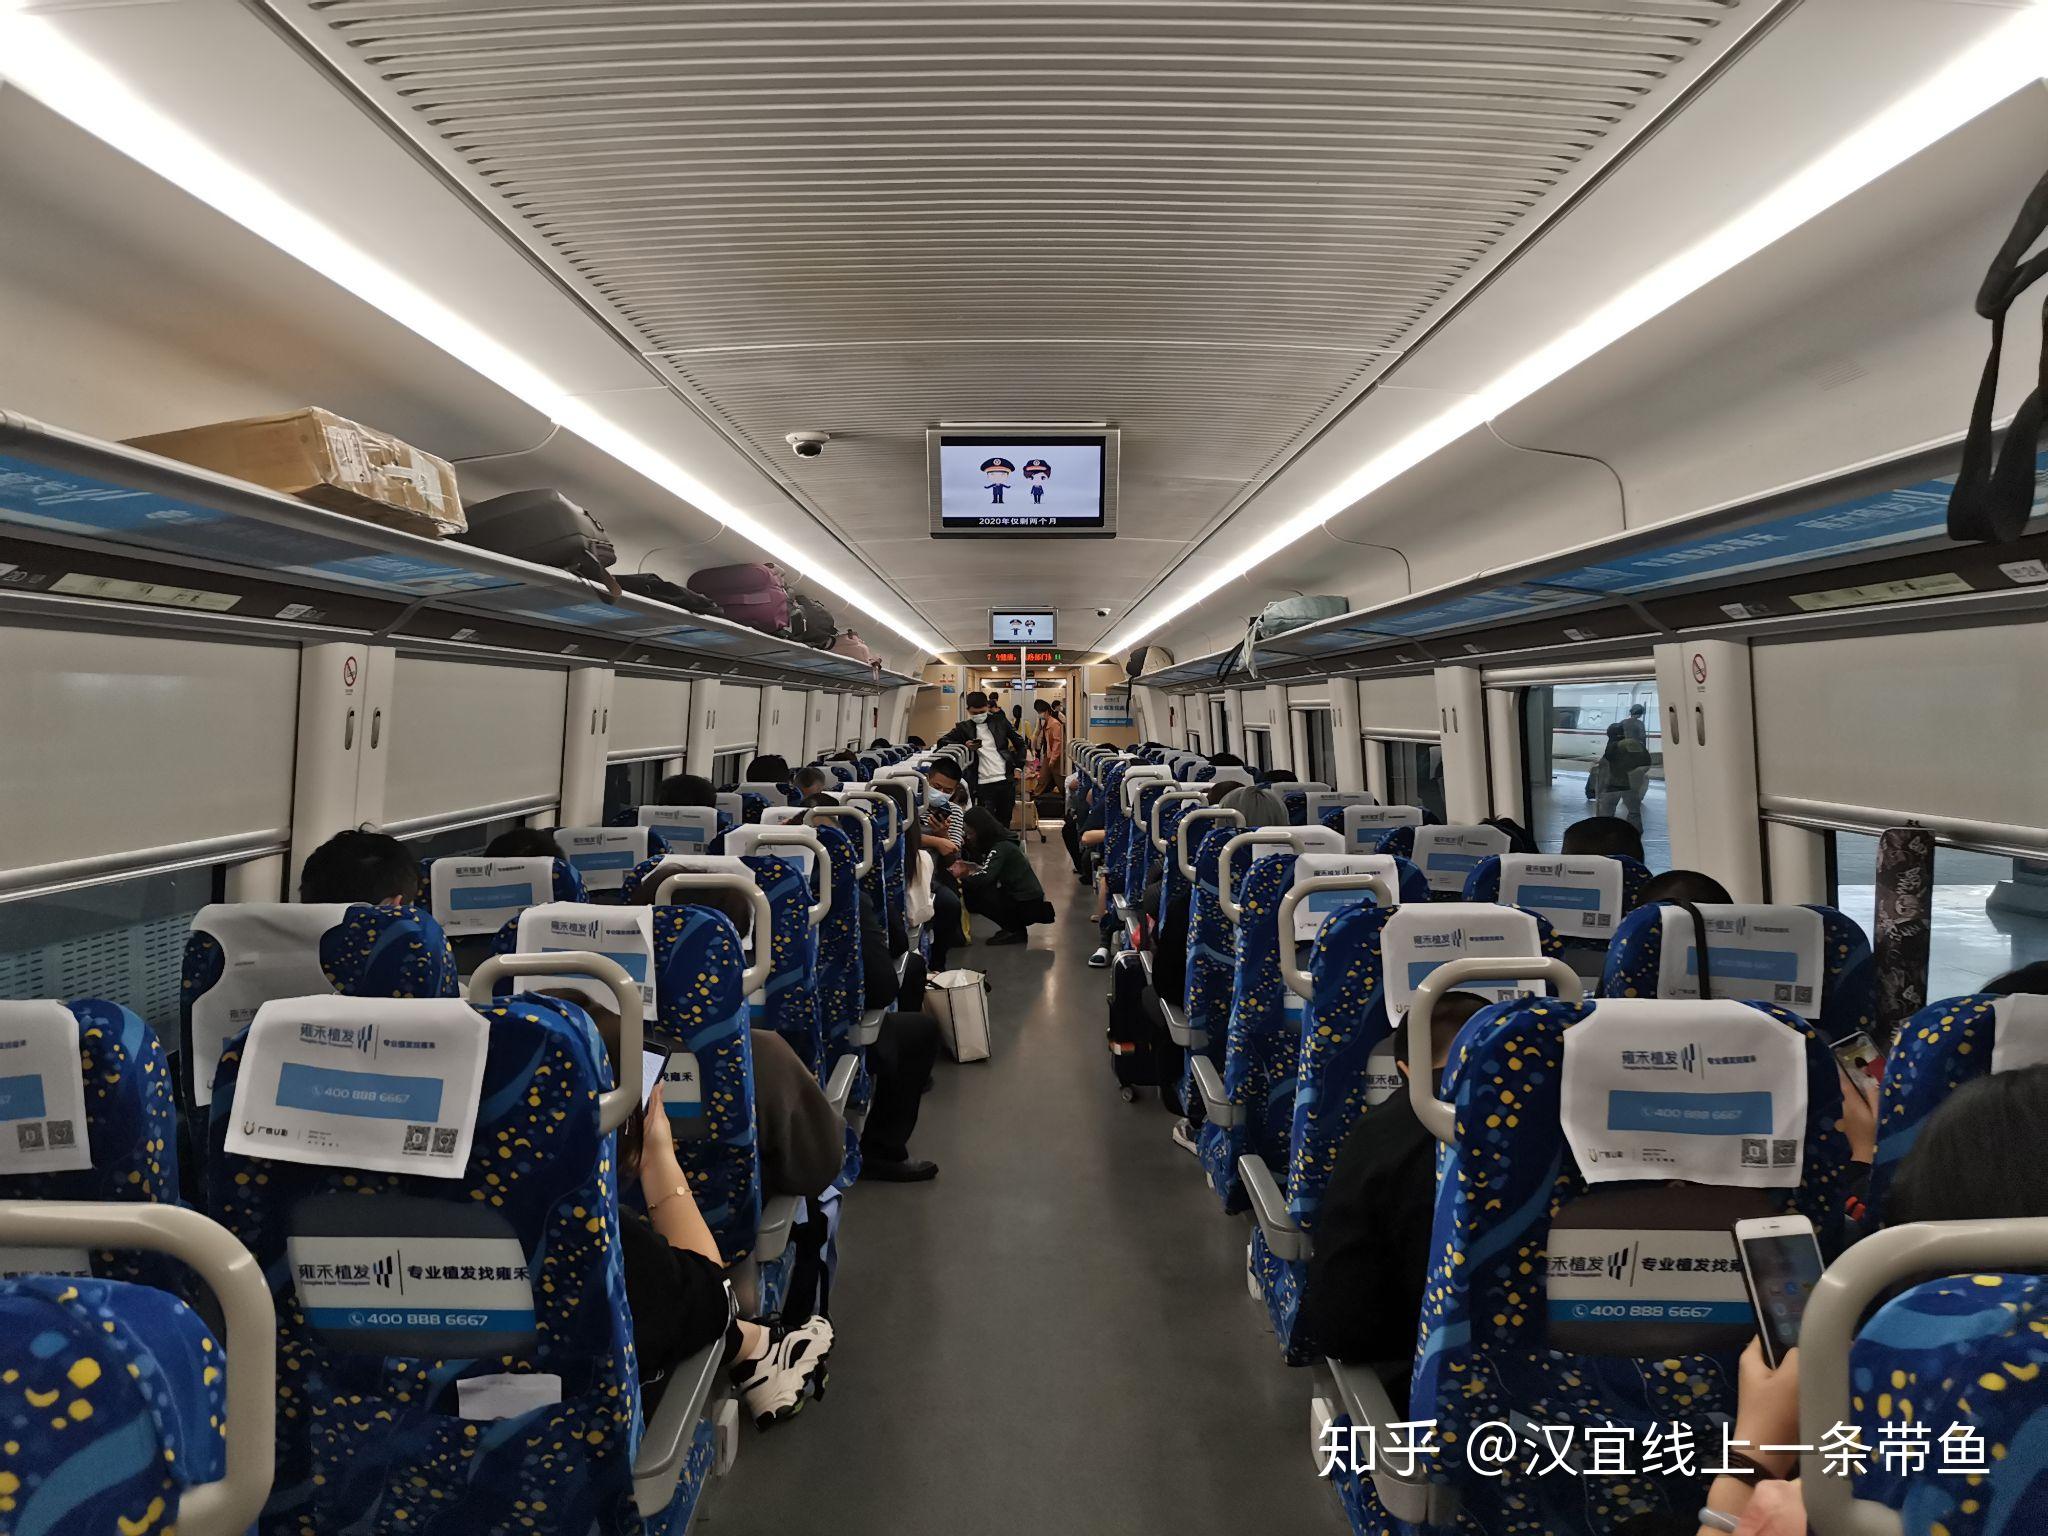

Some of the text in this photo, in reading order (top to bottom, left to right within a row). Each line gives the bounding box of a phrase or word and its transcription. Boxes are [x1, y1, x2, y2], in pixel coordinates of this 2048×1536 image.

[978, 517, 1057, 525] 2020年仅剩两个月
[300, 1022, 354, 1044] 雍禾植发
[1621, 1050, 1679, 1065] 雍禾植发
[323, 1088, 349, 1099] 400
[352, 1090, 376, 1101] 888
[1654, 1108, 1680, 1118] 400
[1547, 1256, 1604, 1272] 禾植发
[298, 1263, 530, 1282] 雍禾植发 专业植发找雍禾
[1590, 1306, 1713, 1318] 400 888 6667
[366, 1314, 488, 1326] 400 888 6667
